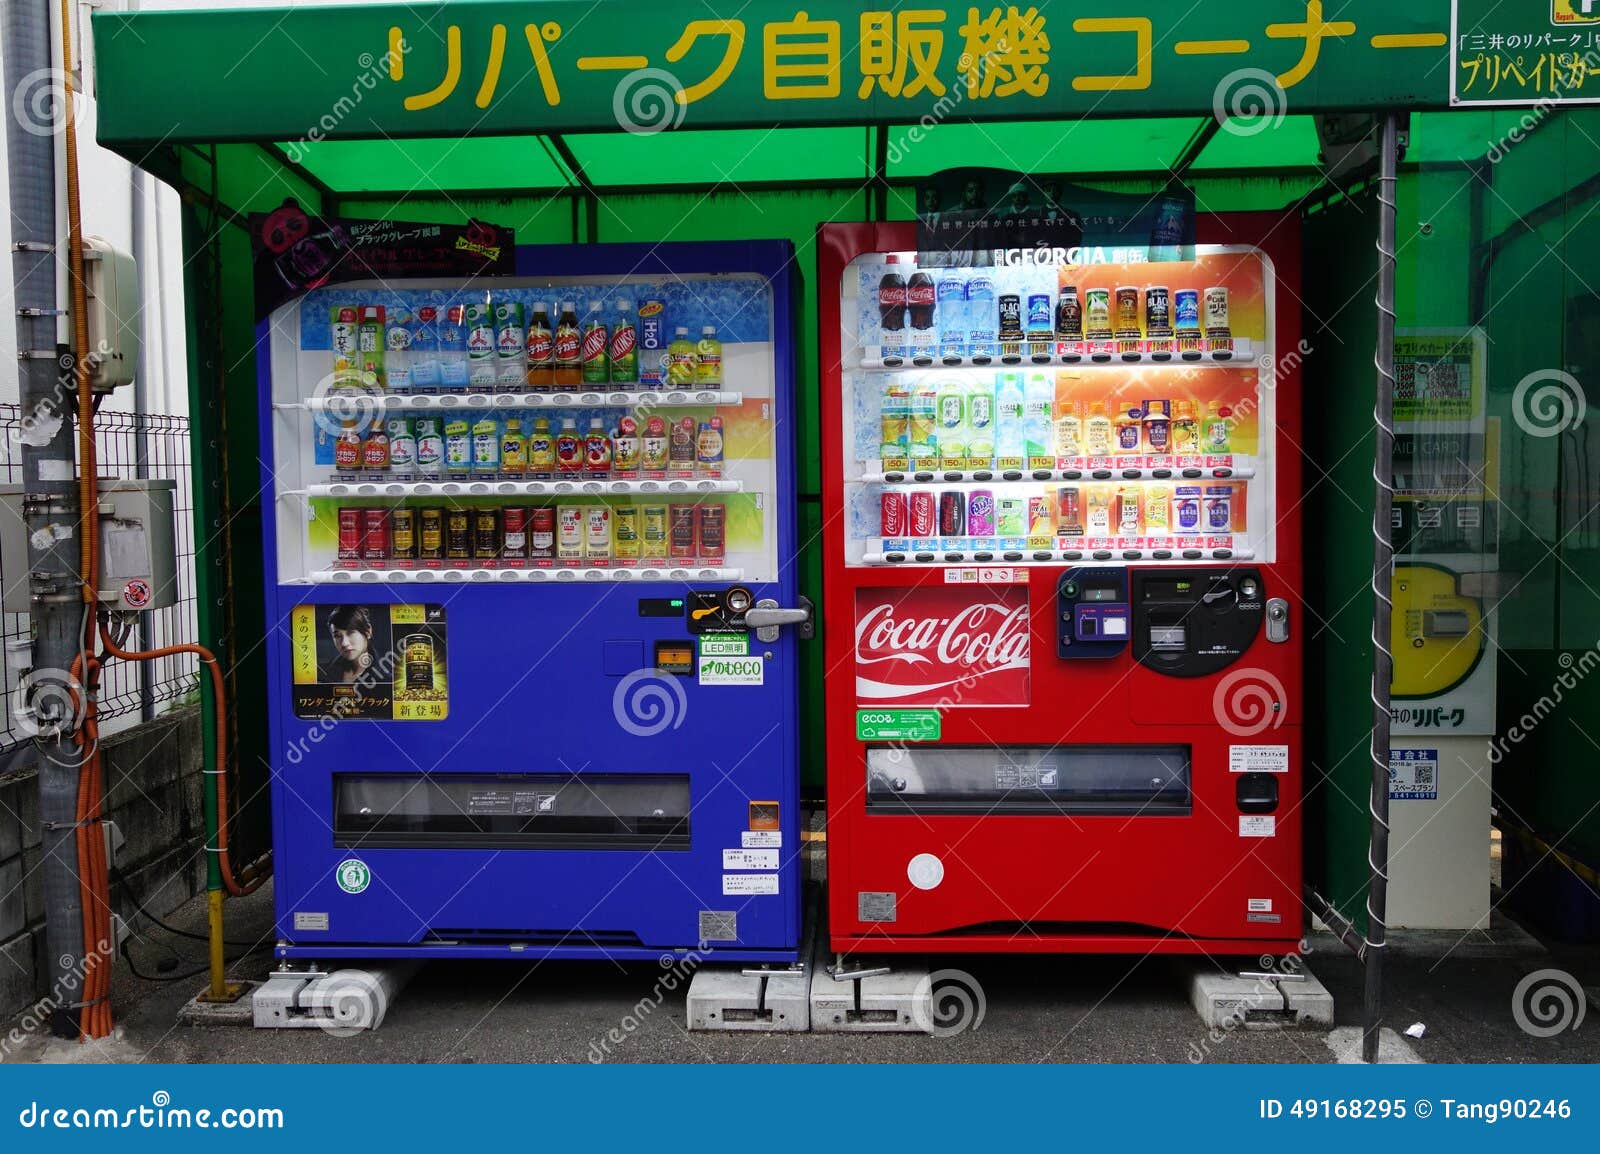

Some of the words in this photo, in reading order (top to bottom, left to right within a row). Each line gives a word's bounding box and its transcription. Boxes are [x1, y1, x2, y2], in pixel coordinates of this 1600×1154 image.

[1460, 32, 1600, 51] 「三井のリパーク」
[388, 0, 1447, 110] リパーク自販機コーナー
[1006, 247, 1107, 267] GEORGIA
[885, 496, 897, 535] Coca-Cola
[915, 496, 928, 534] Coca-Cola
[970, 496, 993, 516] Fanta
[855, 603, 1030, 664] Coca-Cola
[704, 644, 744, 653] LED照明
[714, 661, 761, 676] のむeco
[400, 705, 441, 717] 新登場
